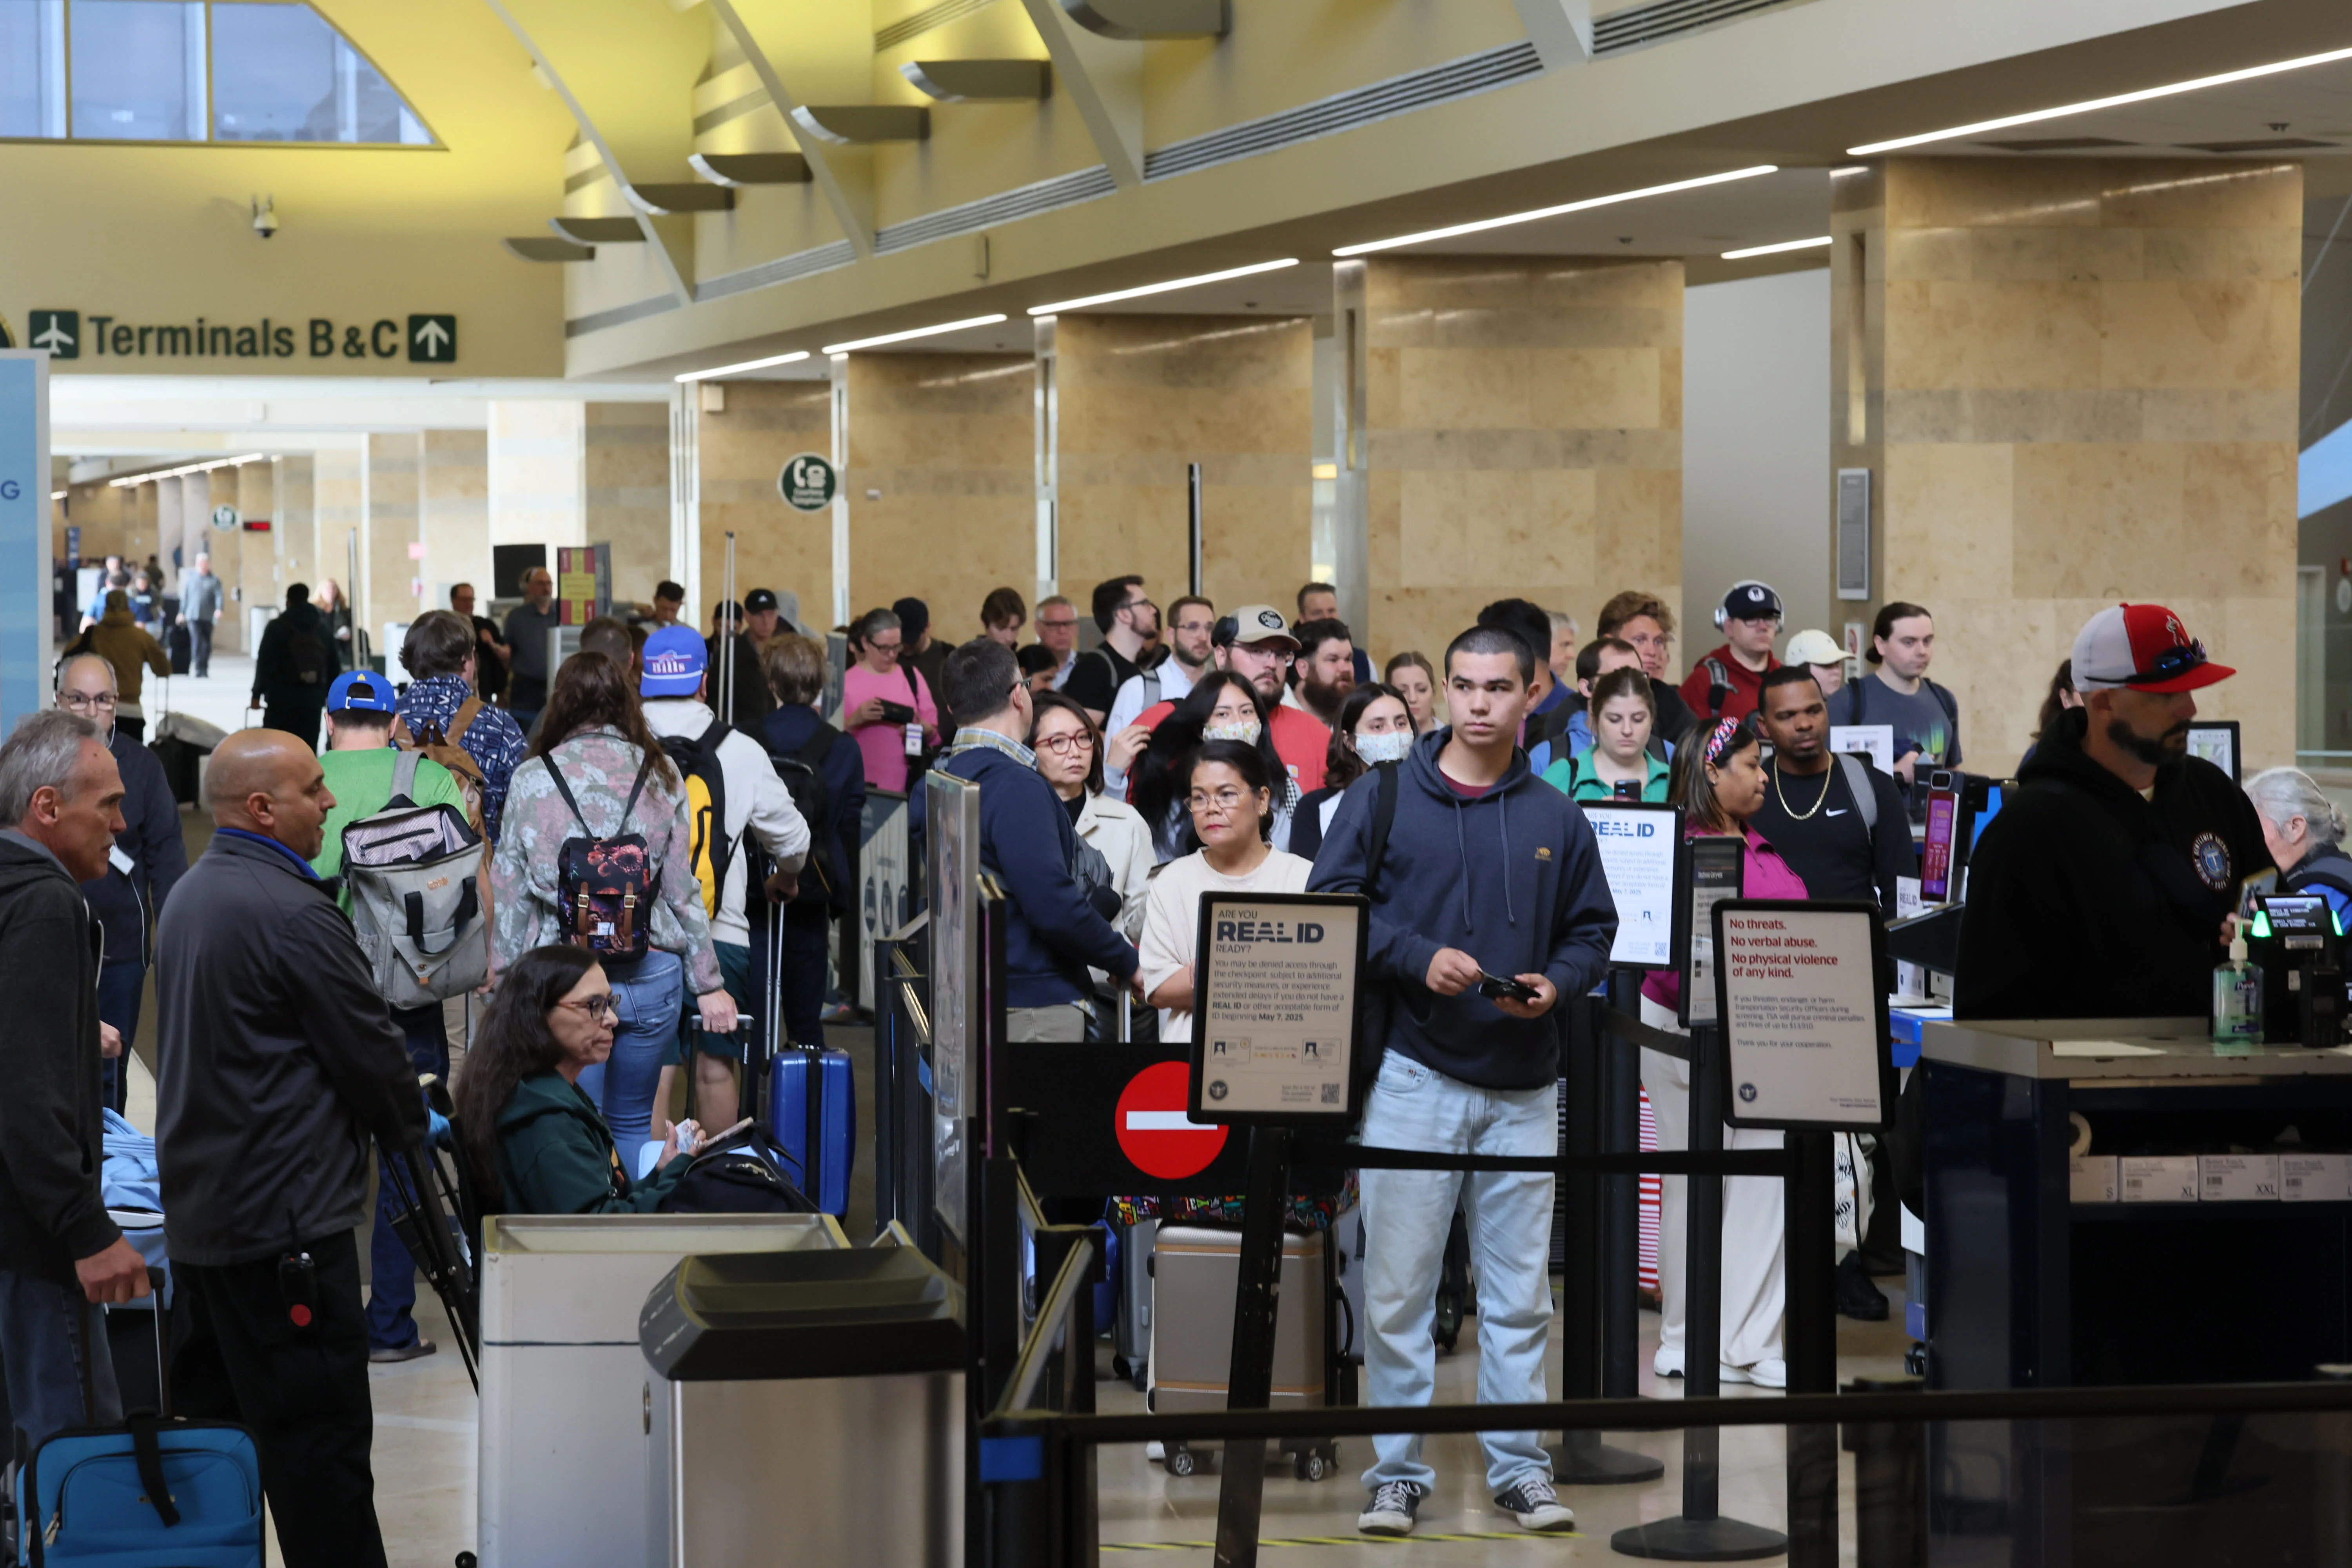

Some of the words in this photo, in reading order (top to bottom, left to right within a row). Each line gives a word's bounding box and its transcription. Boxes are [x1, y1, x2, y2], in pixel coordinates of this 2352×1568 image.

[87, 316, 296, 358] Terminals
[310, 319, 334, 357] B
[343, 328, 366, 358] &
[371, 319, 398, 358] C
[0, 480, 20, 500] G
[652, 661, 686, 673] Bills
[1637, 823, 1654, 837] ID
[1218, 910, 1236, 918] ARE
[1238, 910, 1257, 919] YOU
[1730, 919, 1744, 929] No
[1747, 919, 1787, 930] threats.
[1217, 922, 1293, 942] REAL
[1297, 923, 1324, 943] ID
[1731, 936, 1745, 947] No
[1748, 936, 1781, 947] verbal
[1784, 937, 1817, 948] abuse.
[1216, 944, 1251, 953] READY?
[1732, 954, 1746, 964] No
[1749, 954, 1791, 965] physical
[1794, 955, 1838, 965] violence
[1309, 961, 1337, 970] through
[1270, 971, 1295, 980] subject
[1307, 971, 1341, 980] additional
[1733, 967, 1744, 976] of
[1746, 969, 1765, 979] any
[1768, 967, 1794, 978] kind.
[1214, 981, 1242, 989] security
[1249, 992, 1272, 1000] delays
[1222, 1013, 1257, 1022] beginning
[2106, 1187, 2113, 1198] S
[2181, 1186, 2194, 1197] XL
[2256, 1183, 2276, 1195] XXL
